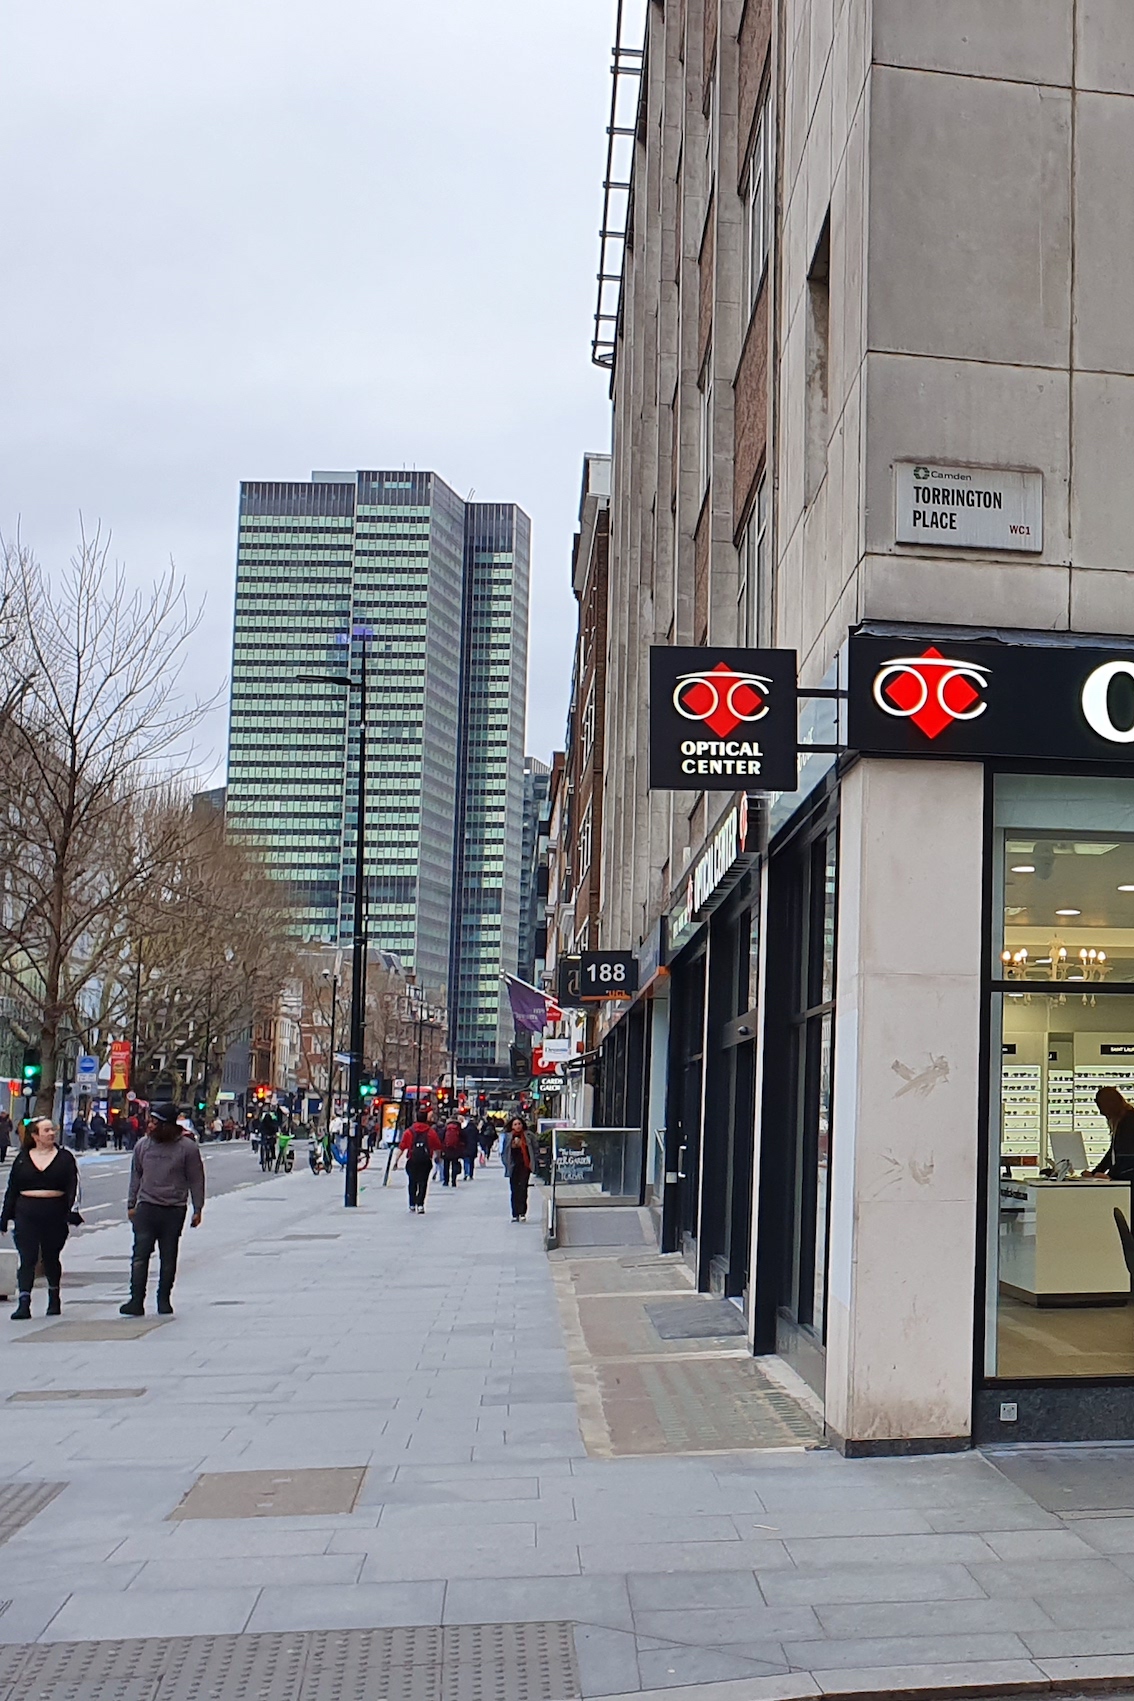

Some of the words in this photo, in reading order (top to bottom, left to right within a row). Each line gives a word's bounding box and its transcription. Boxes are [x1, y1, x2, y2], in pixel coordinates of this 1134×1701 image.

[930, 470, 972, 481] Camden
[913, 486, 1002, 509] TORRINGTON
[912, 510, 957, 530] PLACE
[1009, 525, 1031, 535] WC1
[680, 740, 764, 757] OPTICAL
[681, 759, 762, 775] CENTER
[586, 963, 626, 982] 188
[541, 1077, 564, 1085] CARDS
